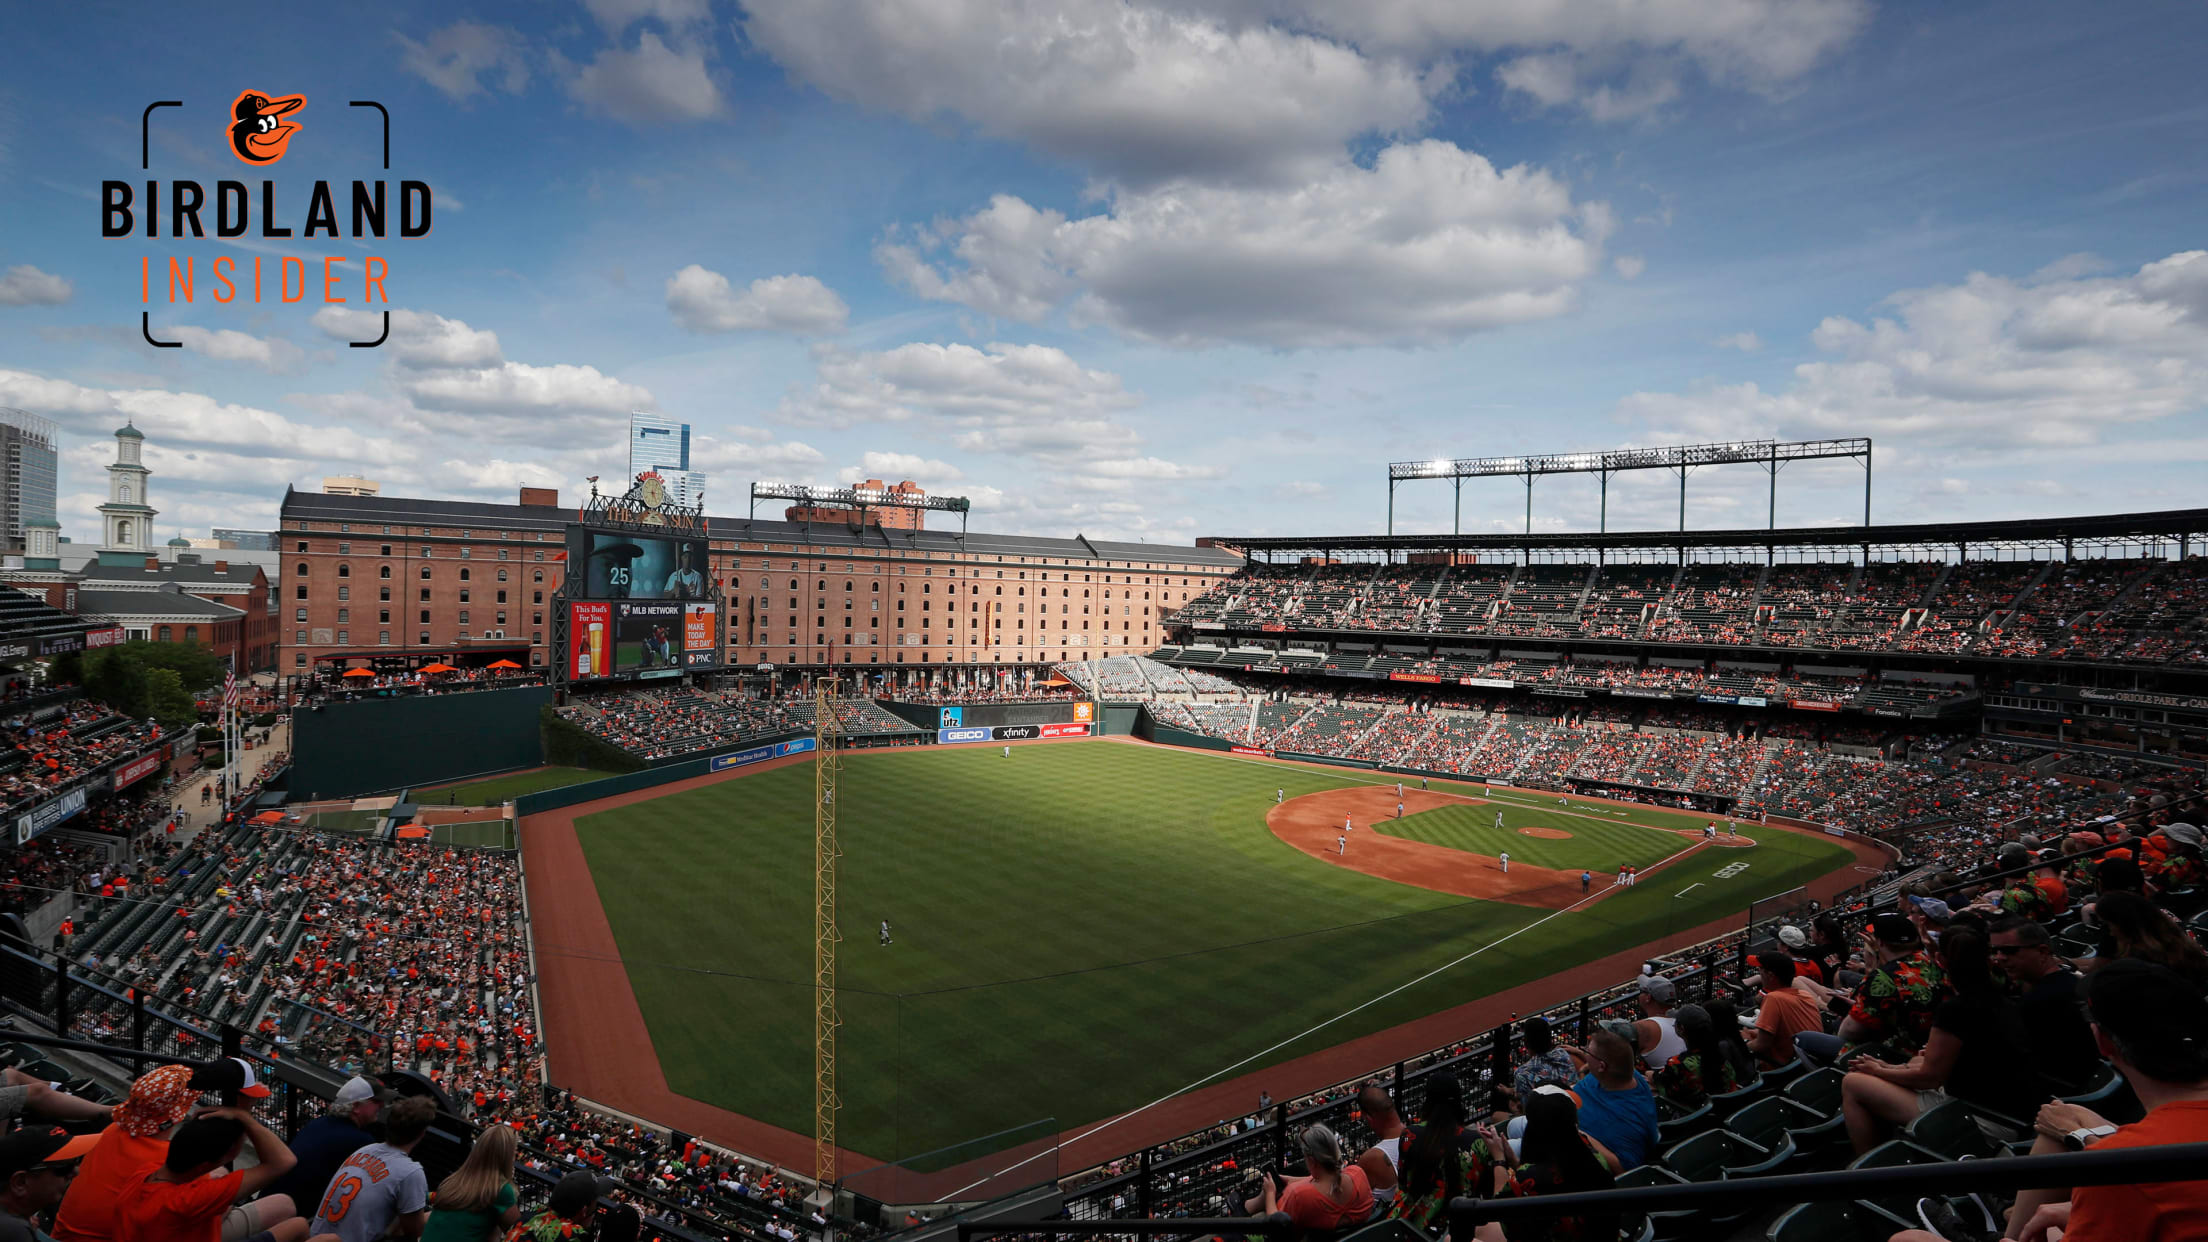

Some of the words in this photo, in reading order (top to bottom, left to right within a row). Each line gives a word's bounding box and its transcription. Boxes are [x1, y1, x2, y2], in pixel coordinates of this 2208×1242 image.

[608, 506, 633, 522] THE
[671, 514, 694, 529] SUN
[610, 567, 629, 585] 25
[575, 605, 590, 613] This
[591, 605, 608, 613] Bud's
[632, 606, 646, 615] MLB
[647, 606, 679, 615] NETWORK
[688, 623, 705, 631] MAKE
[687, 631, 706, 639] TODAY
[687, 640, 699, 648] THE
[696, 653, 712, 663] PNC
[2115, 692, 2153, 704] ORIOLE
[2153, 696, 2179, 706] PARK
[1875, 708, 1901, 717] Fanatics
[943, 718, 959, 727] utz
[947, 730, 984, 740] GEICO
[1003, 727, 1030, 739] xfinity
[790, 743, 804, 752] pepsi
[753, 750, 768, 759] Health
[60, 787, 85, 816] UNION
[1711, 861, 1751, 879] GEICO
[318, 1171, 363, 1223] 13
